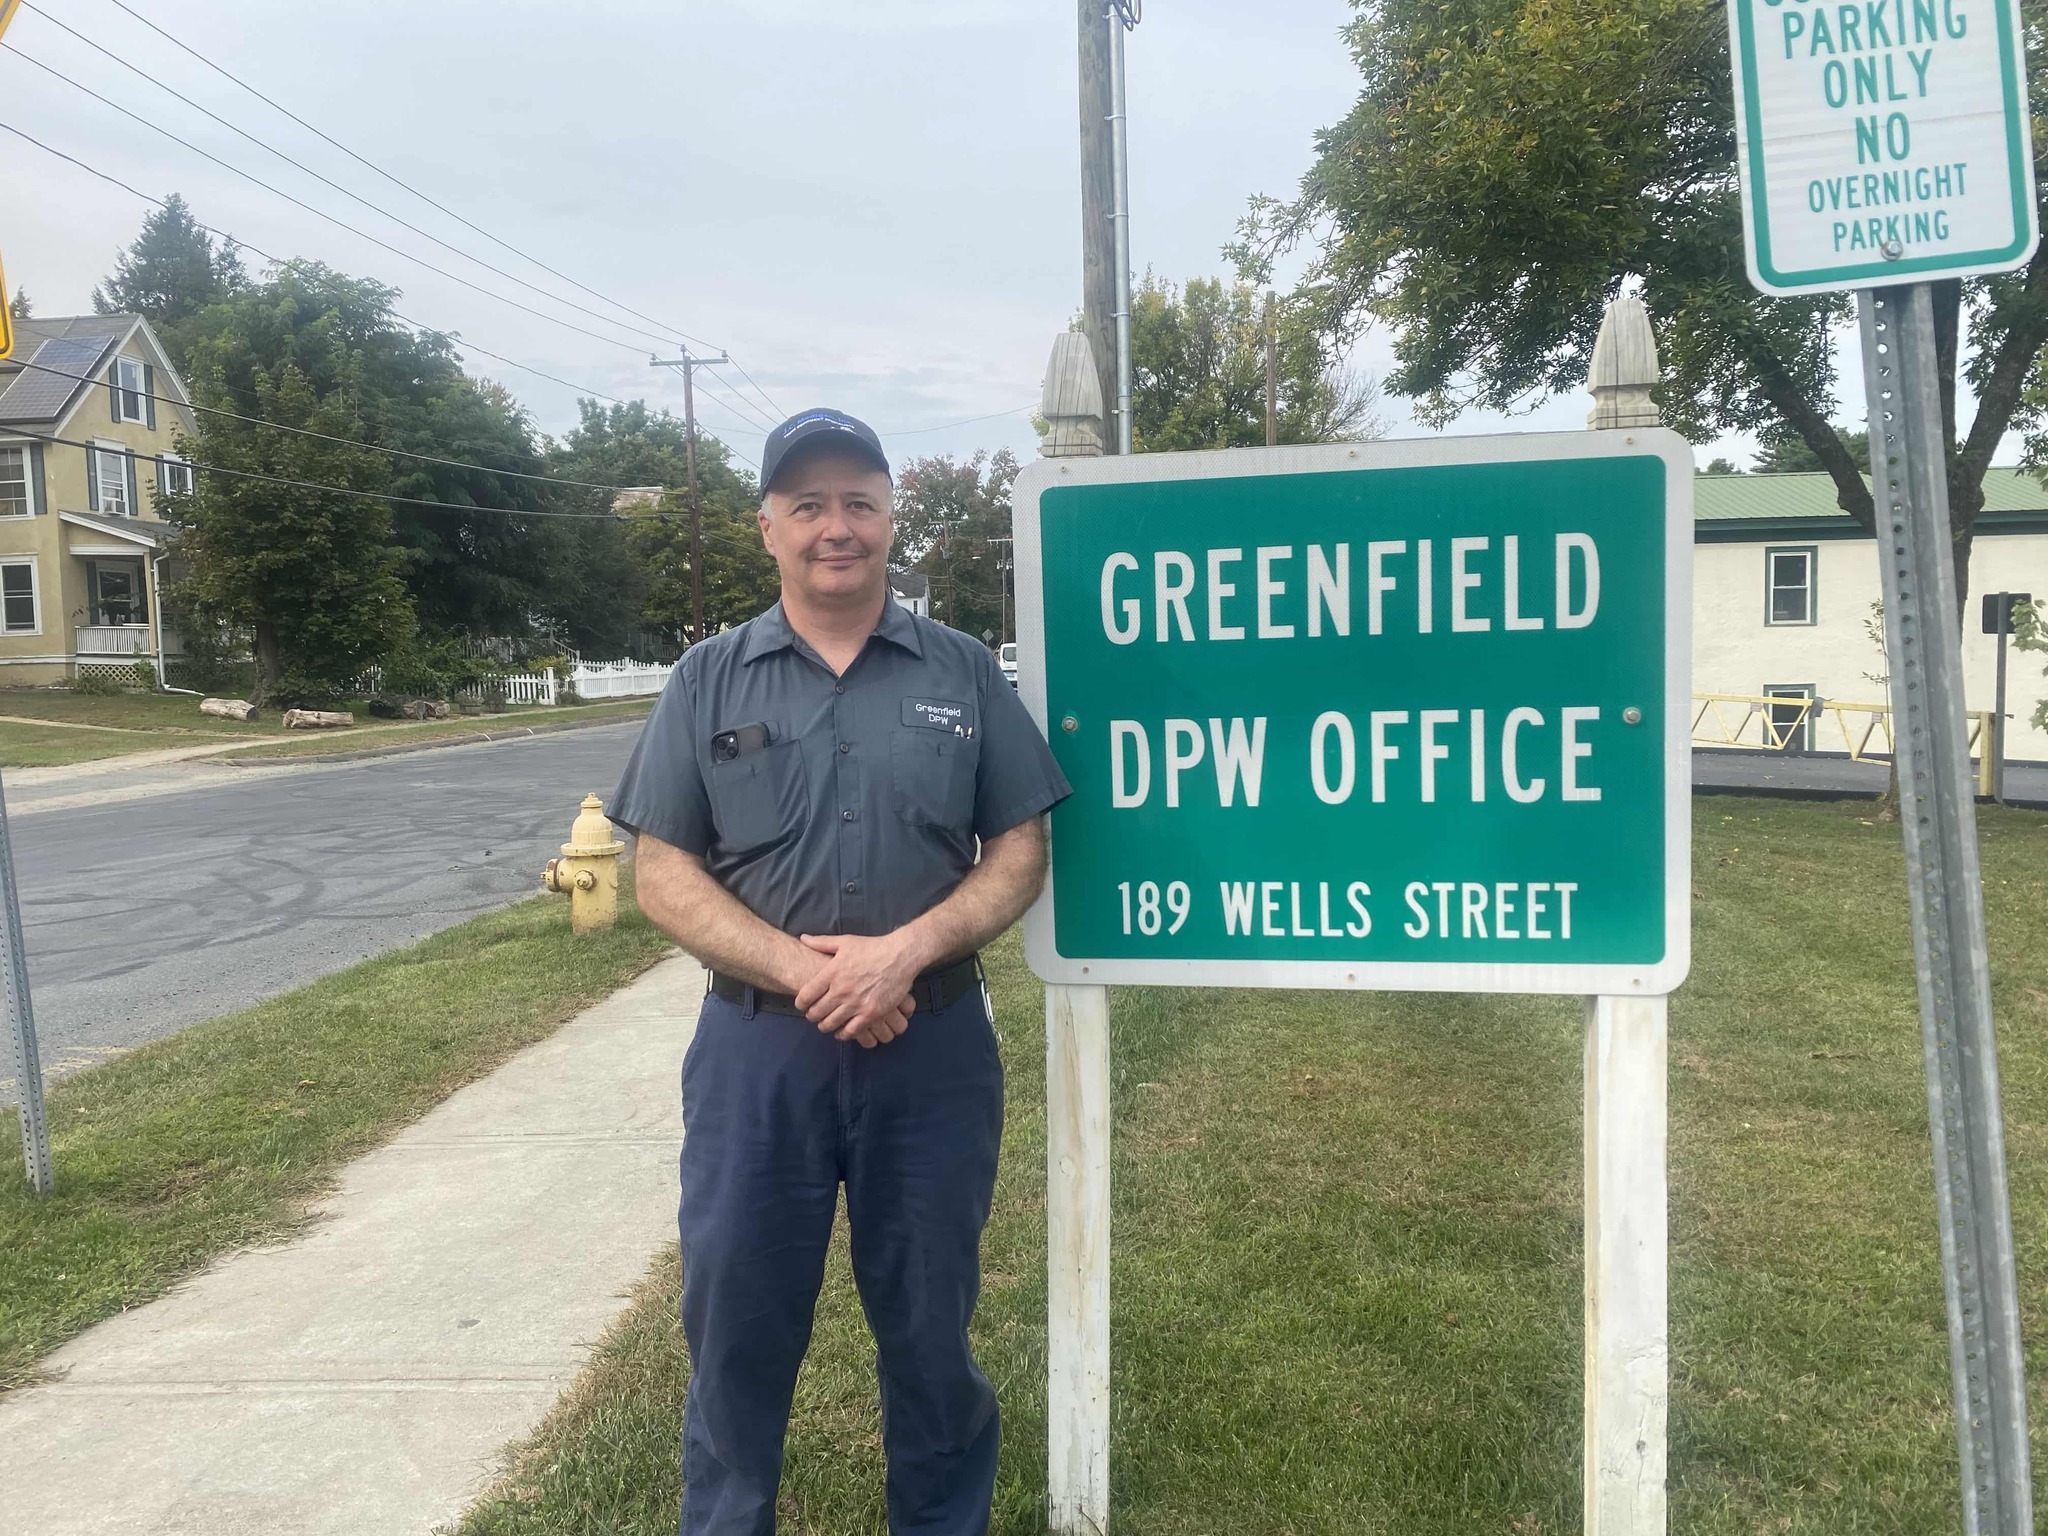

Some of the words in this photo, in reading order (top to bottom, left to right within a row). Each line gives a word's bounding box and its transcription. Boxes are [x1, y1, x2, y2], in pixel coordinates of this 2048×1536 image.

[1782, 0, 1967, 59] PARKING
[1823, 48, 1932, 109] ONLY
[1854, 112, 1911, 164] NO
[1808, 163, 1967, 213] OVERNIGHT
[1832, 209, 1950, 252] PARKING
[1100, 532, 1600, 645] GREENFIELD
[915, 703, 961, 717] Greenfield
[928, 713, 949, 725] DPW
[1110, 716, 1267, 808] DPW
[1310, 706, 1602, 805] OFFICE
[1118, 880, 1191, 936] 189
[1220, 881, 1372, 938] WELLS
[1404, 882, 1578, 939] STREET
